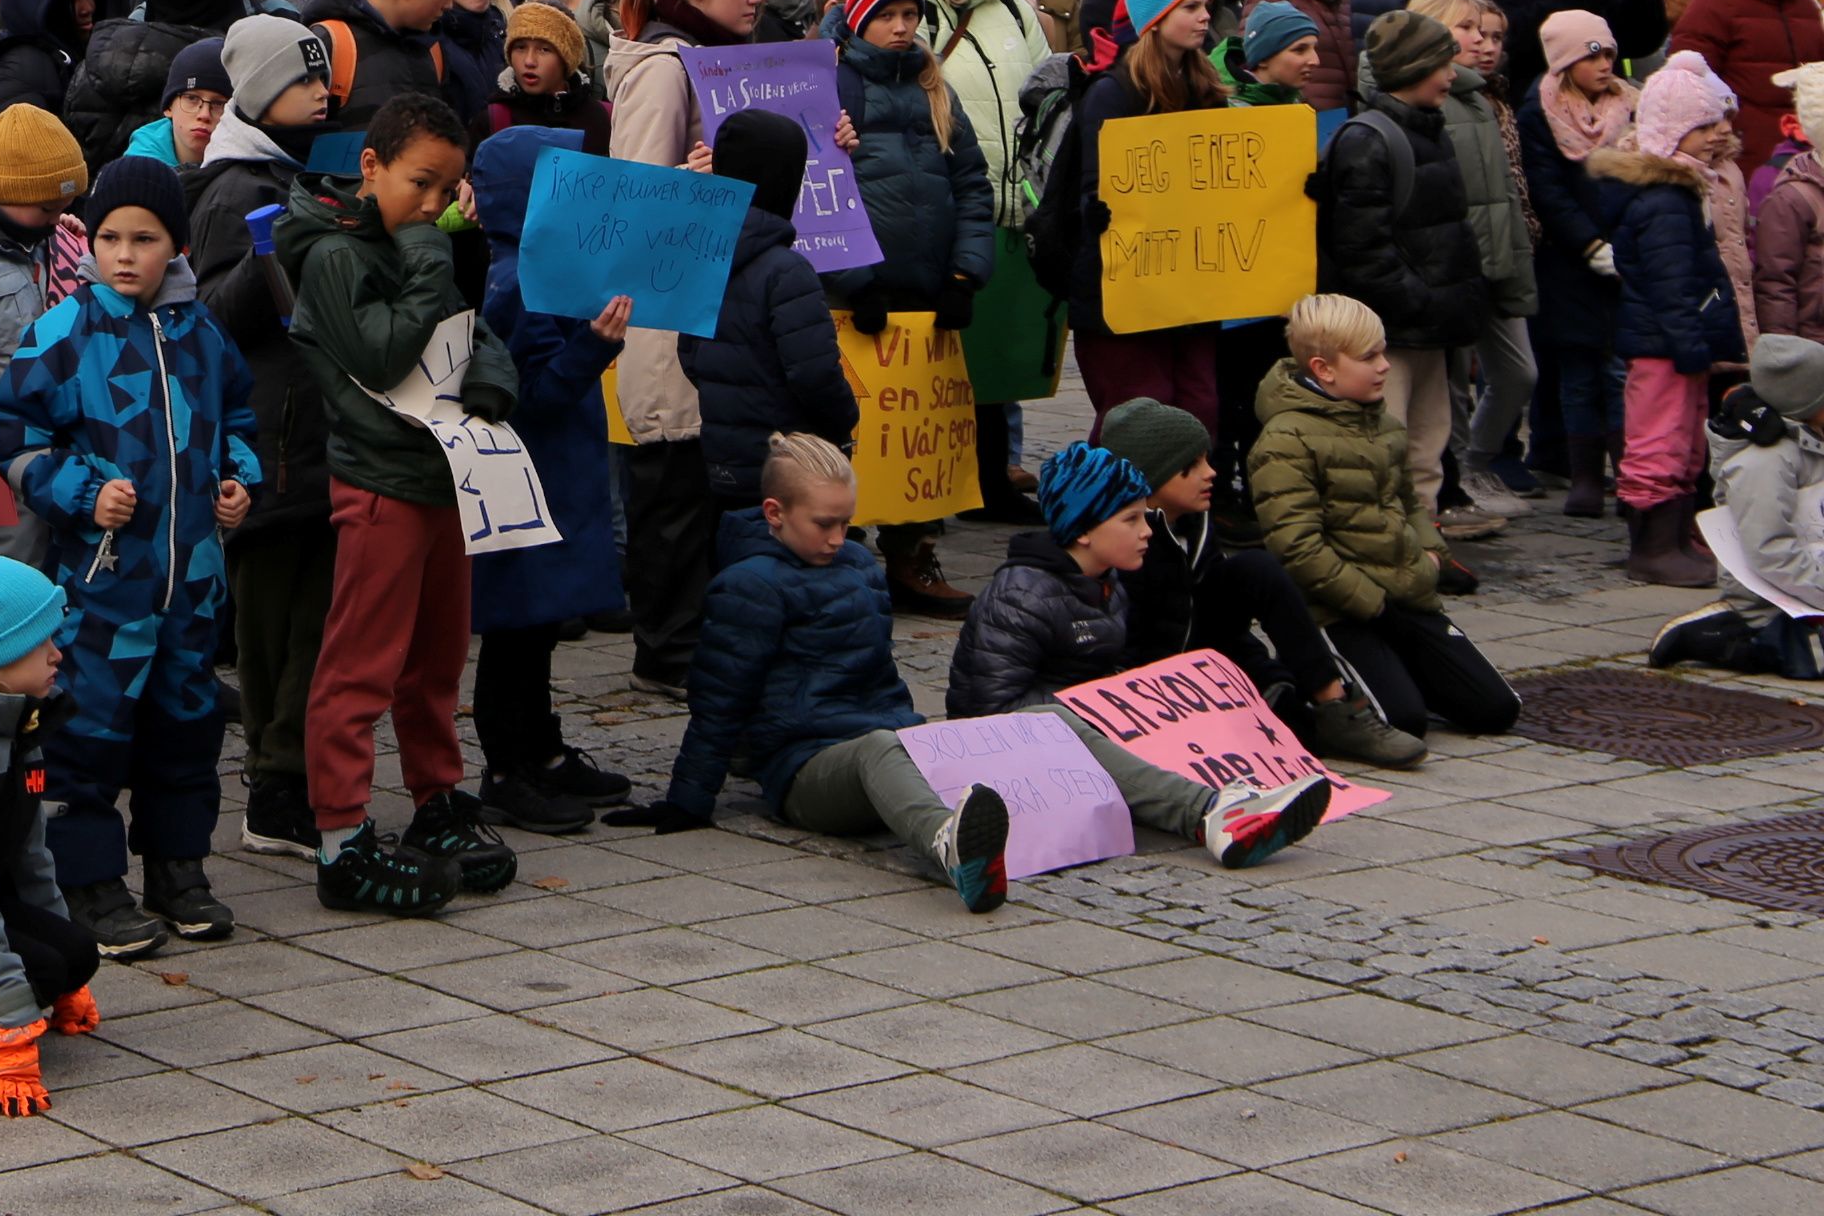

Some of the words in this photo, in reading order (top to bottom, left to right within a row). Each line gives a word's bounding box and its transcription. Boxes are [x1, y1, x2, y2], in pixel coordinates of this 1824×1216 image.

[710, 85, 737, 115] LA
[878, 386, 920, 412] en
[880, 423, 890, 458] i
[911, 723, 1013, 763] SKOLEN
